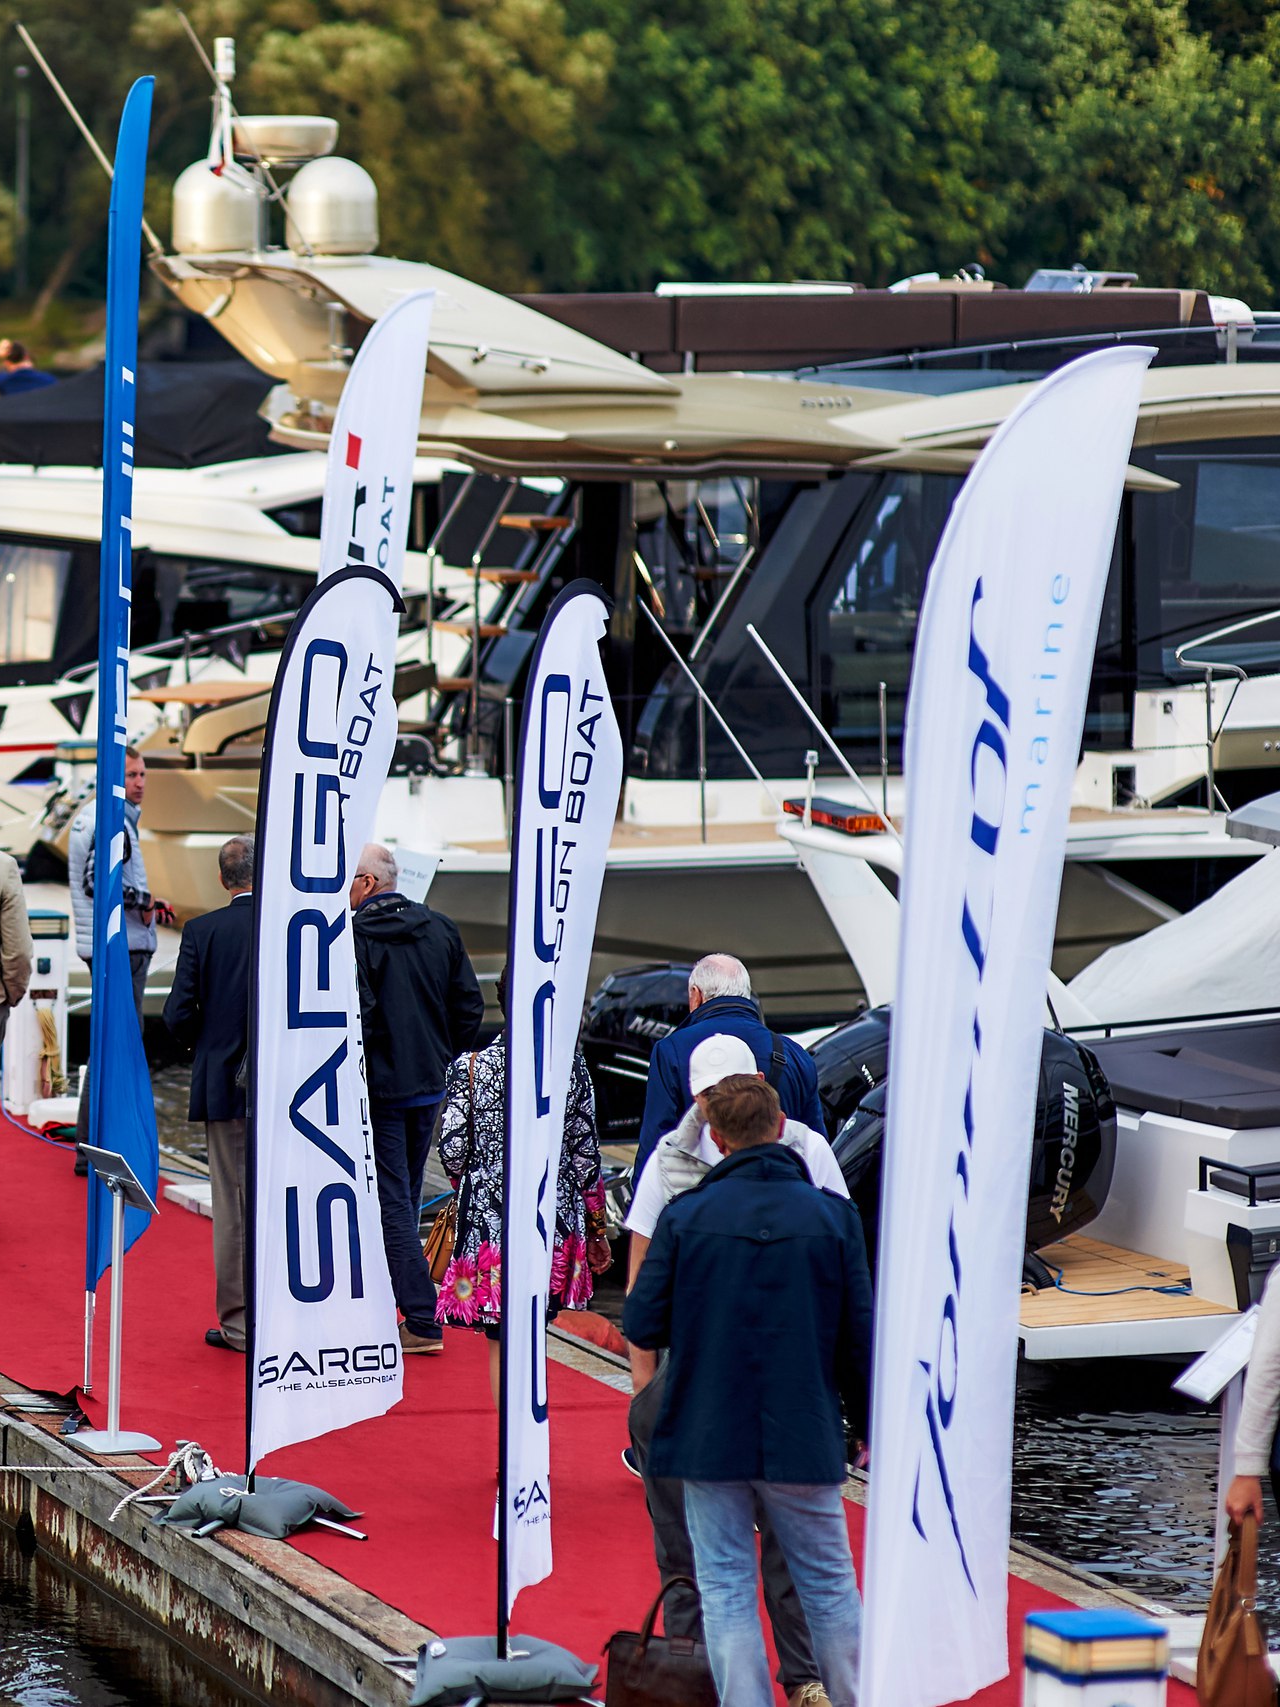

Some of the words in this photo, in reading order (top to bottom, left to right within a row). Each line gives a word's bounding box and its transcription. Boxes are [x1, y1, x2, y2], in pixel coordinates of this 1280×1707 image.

[377, 476, 395, 569] OAT
[340, 653, 383, 779] BOAT
[565, 679, 604, 823] BOAT
[1018, 572, 1071, 836] marine
[286, 638, 364, 1303] SARGO
[1050, 1081, 1079, 1224] MERCURY
[258, 1343, 397, 1388] SARGO
[277, 1382, 302, 1392] THE
